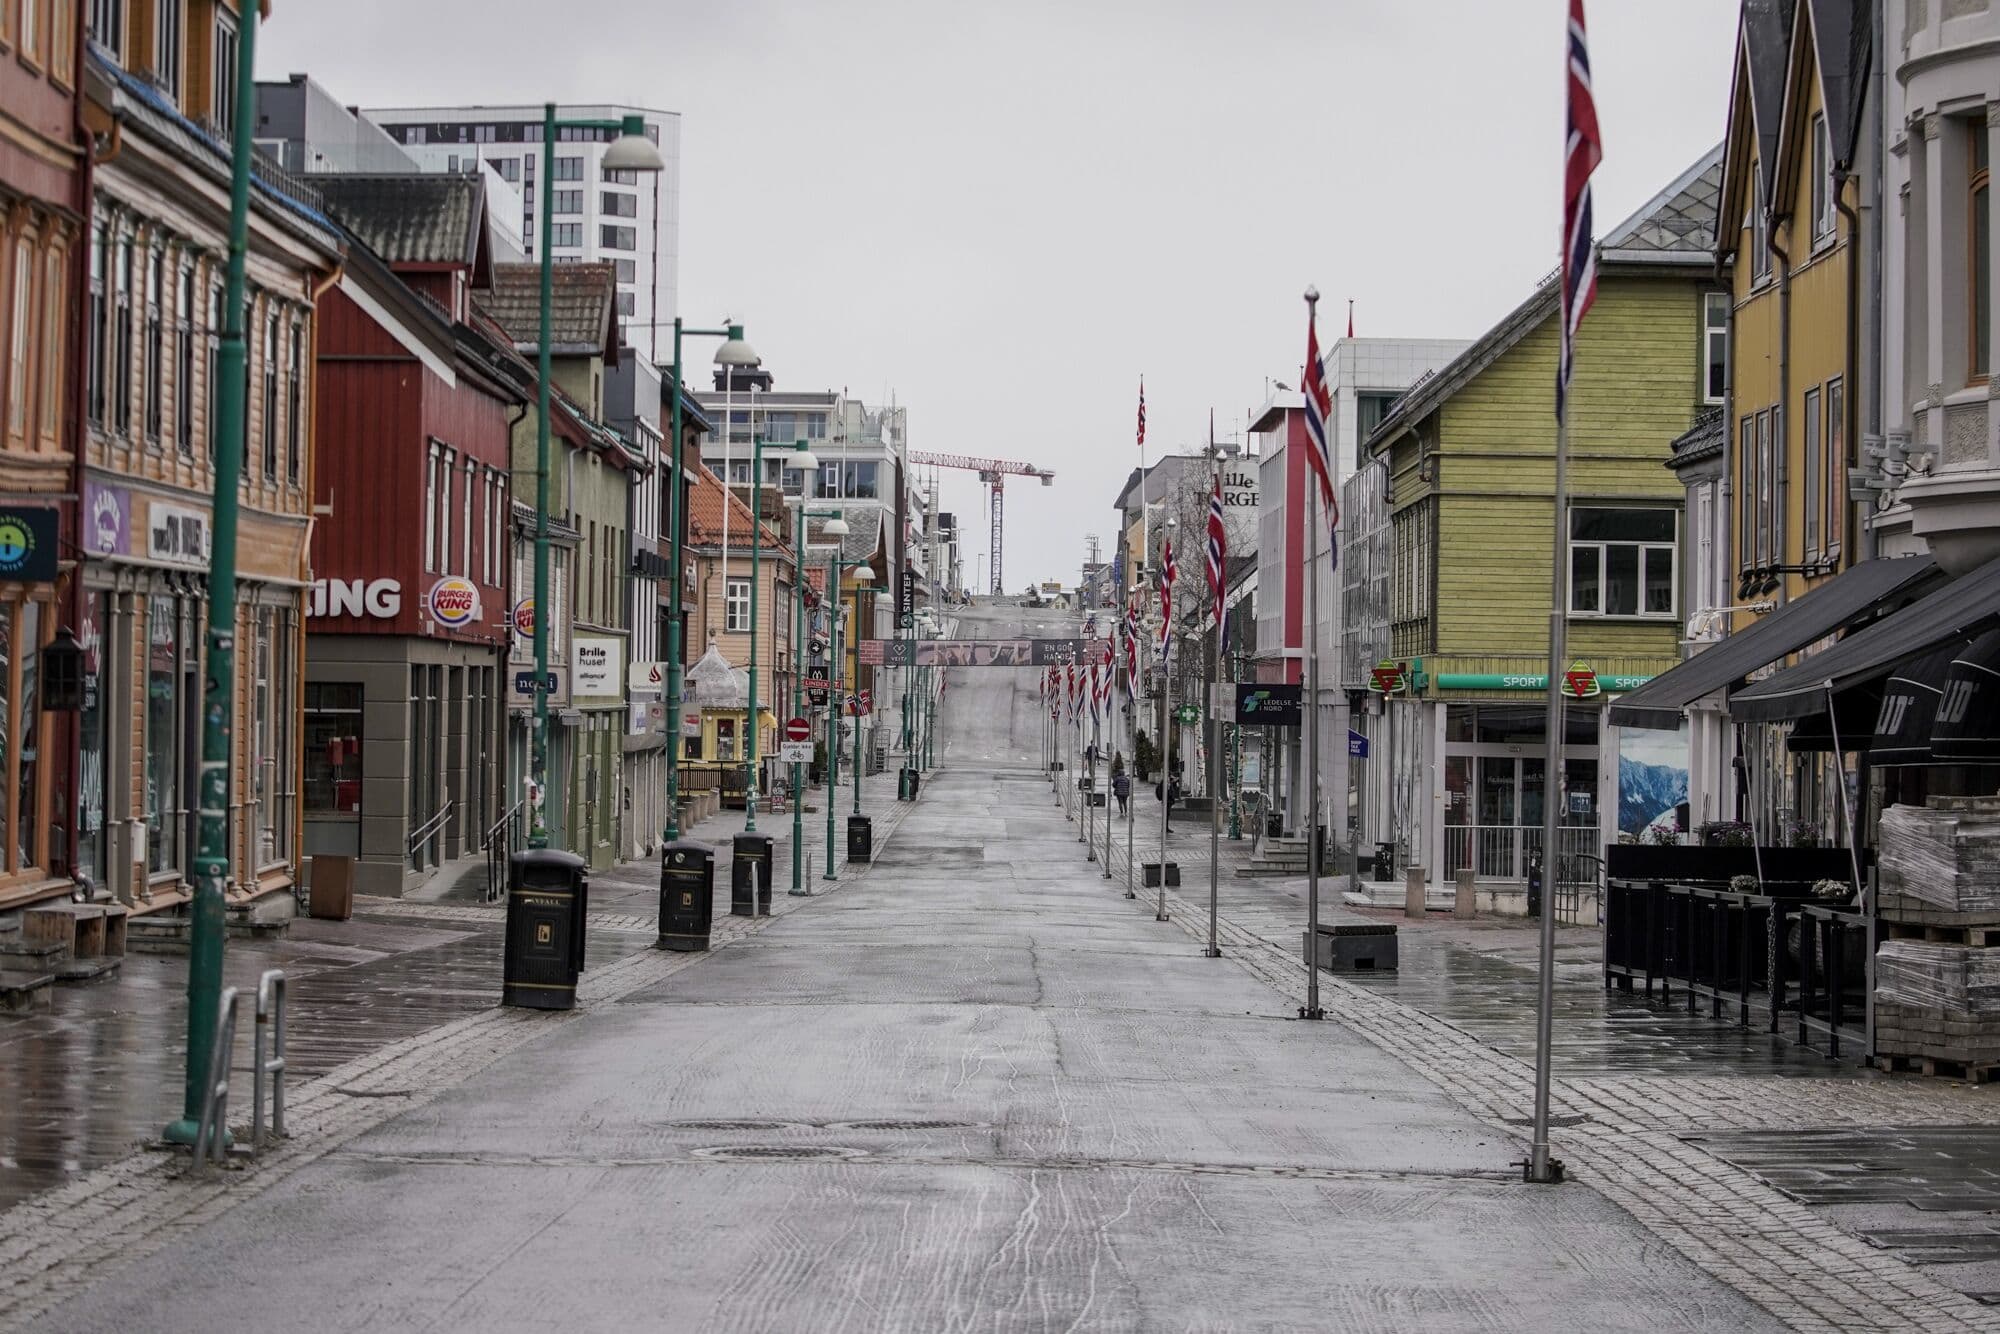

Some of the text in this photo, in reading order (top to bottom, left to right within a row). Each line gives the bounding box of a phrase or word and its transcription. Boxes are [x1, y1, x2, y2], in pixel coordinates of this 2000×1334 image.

[1212, 472, 1254, 488] ille
[305, 578, 401, 618] ING
[437, 589, 473, 600] BURGER
[903, 574, 911, 612] SINTEF
[436, 599, 472, 610] KING
[580, 647, 606, 657] Brille
[579, 657, 606, 666] huset
[519, 678, 554, 689] noi
[1503, 676, 1544, 687] SPORT
